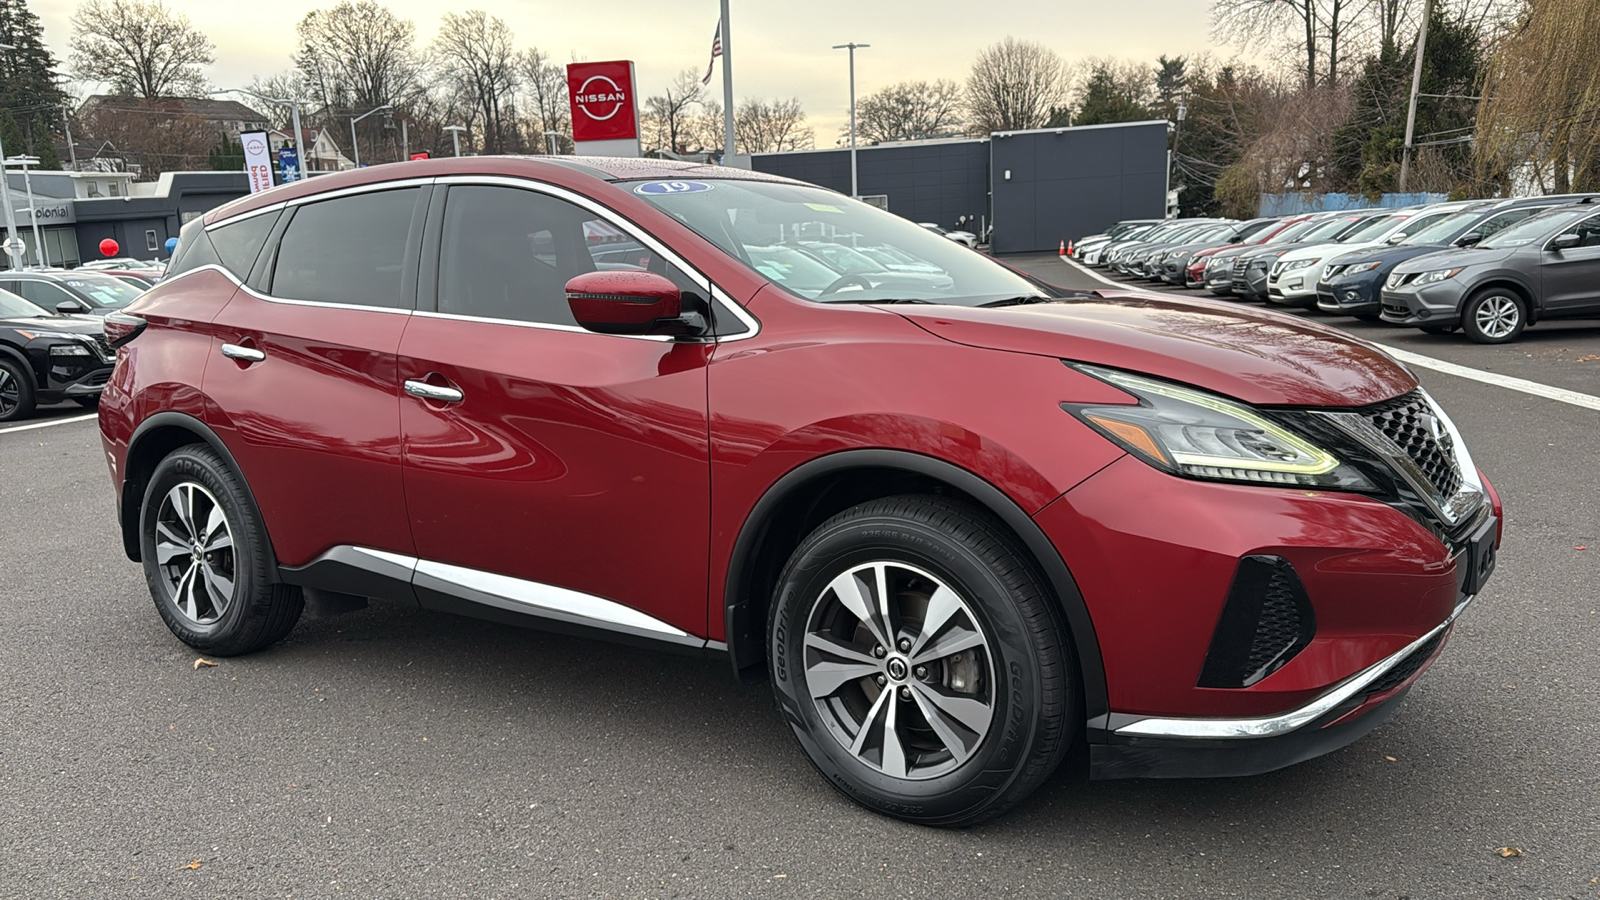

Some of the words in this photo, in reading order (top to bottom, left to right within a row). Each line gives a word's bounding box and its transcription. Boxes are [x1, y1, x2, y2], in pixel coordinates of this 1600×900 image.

[575, 92, 625, 104] NISSAN
[657, 181, 691, 193] 19
[861, 530, 898, 540] 235/65
[776, 590, 797, 682] GeoDrive
